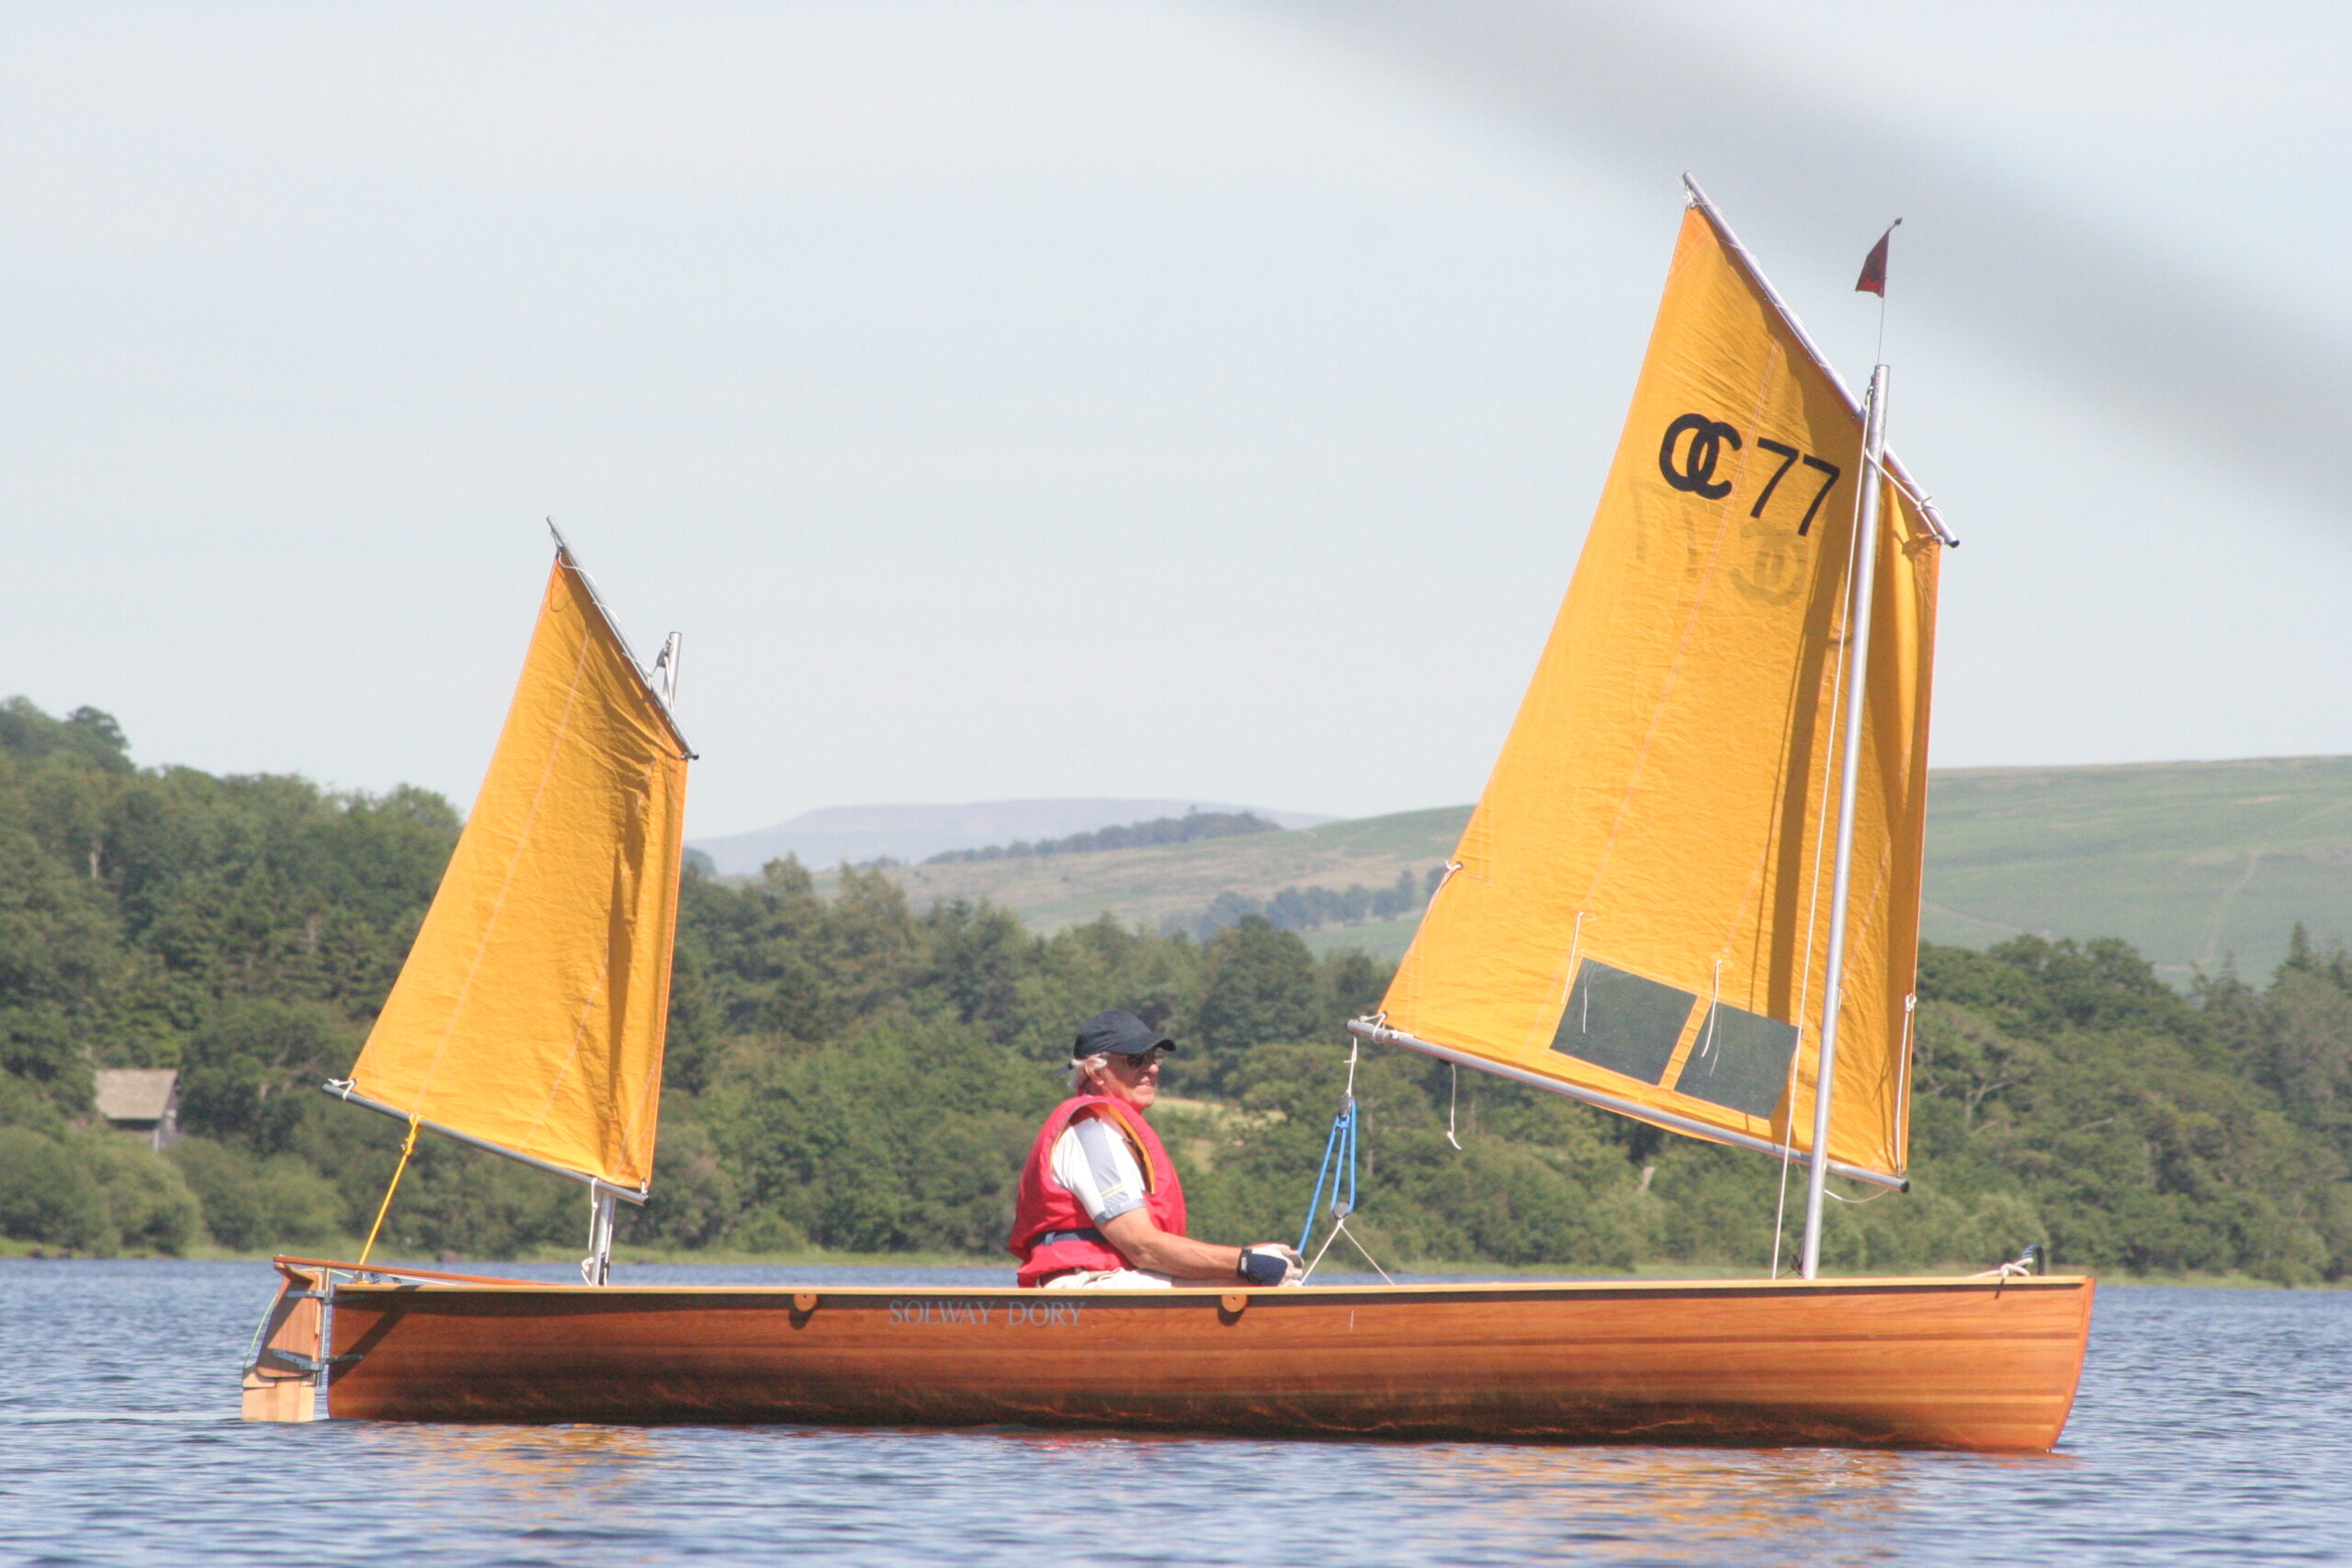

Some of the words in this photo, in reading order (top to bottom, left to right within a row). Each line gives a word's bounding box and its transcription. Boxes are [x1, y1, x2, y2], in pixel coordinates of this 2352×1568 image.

[1750, 437, 1840, 536] 77
[888, 1300, 995, 1325] SOLWAY
[1007, 1301, 1086, 1326] DORY
